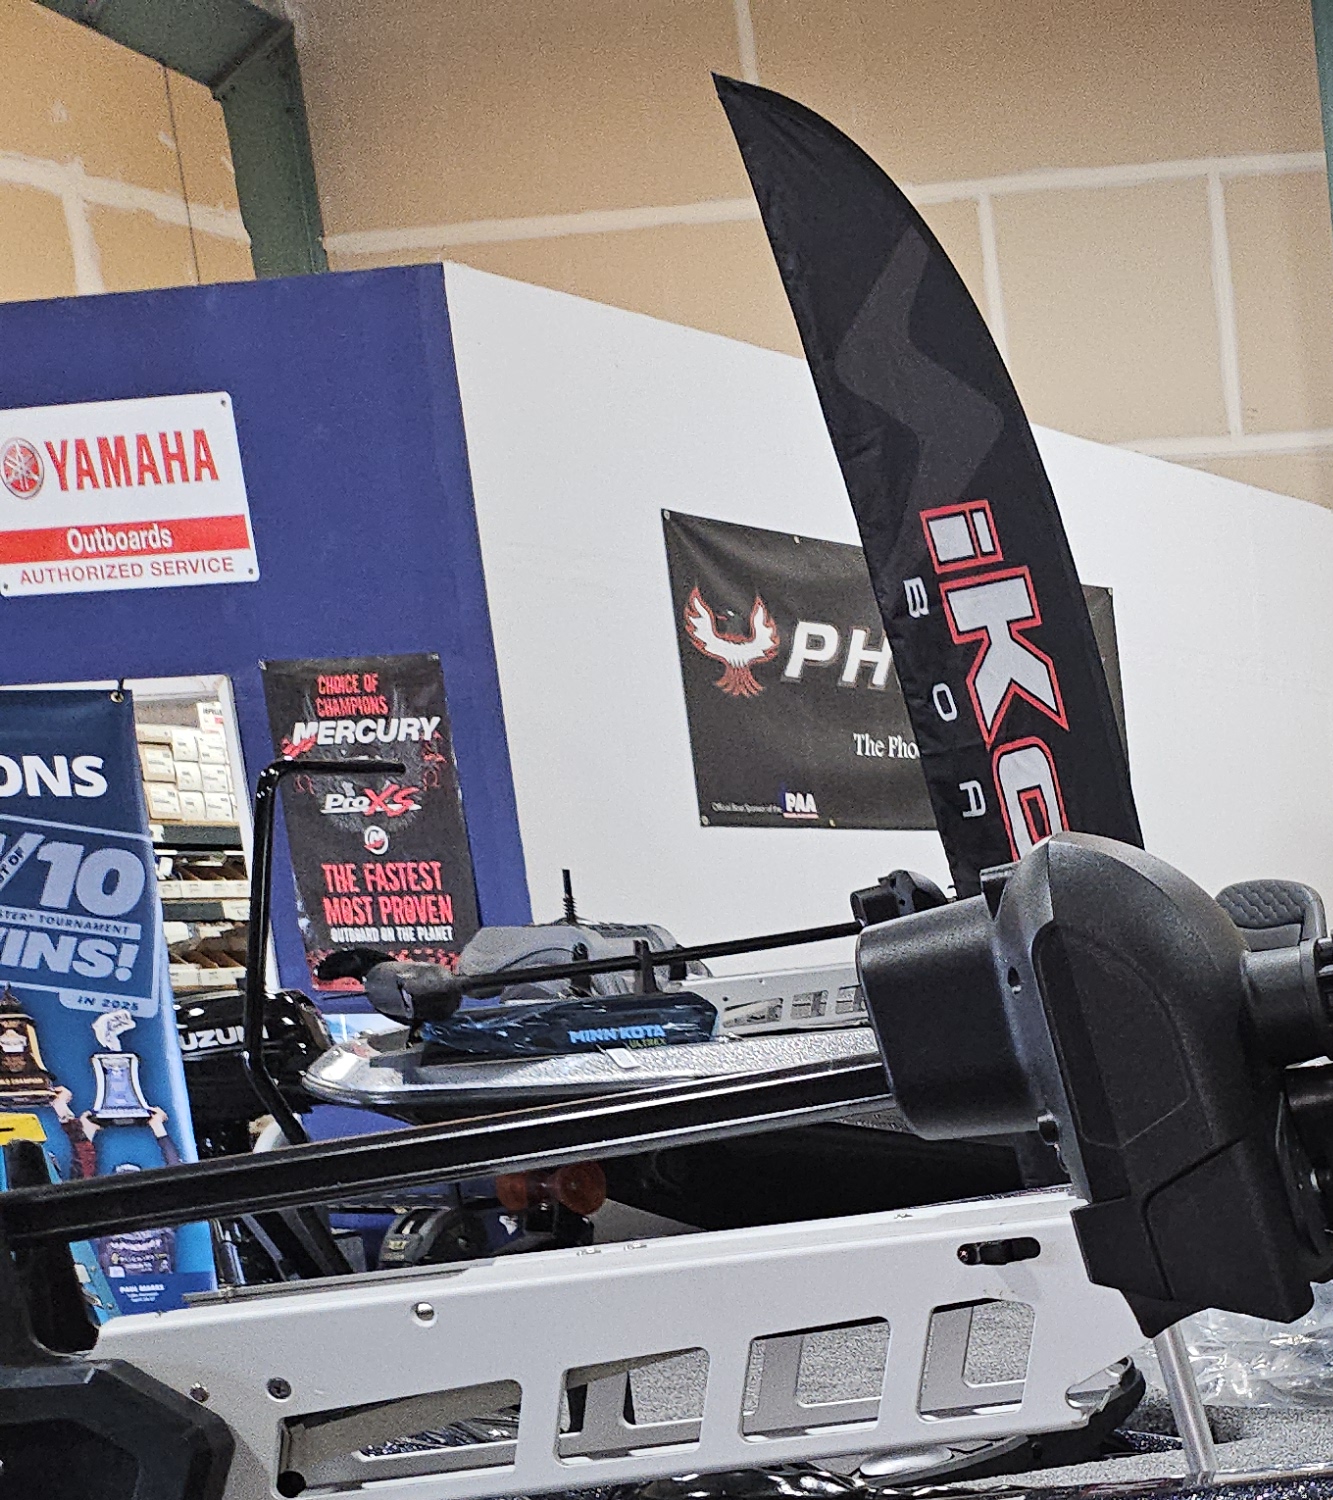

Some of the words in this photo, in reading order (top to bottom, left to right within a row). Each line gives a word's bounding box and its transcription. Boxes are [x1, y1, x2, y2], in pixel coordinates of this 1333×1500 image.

[44, 429, 219, 491] YAMAHA
[67, 523, 173, 554] Outboards
[20, 562, 143, 585] AUTHORIZED
[151, 557, 234, 577] SERVICE
[317, 674, 360, 695] CHOICE
[363, 672, 378, 693] OF
[315, 695, 389, 718] CHAMPIONS
[292, 716, 441, 746] MERCURY
[854, 733, 886, 757] The
[784, 791, 818, 814] PAA
[321, 863, 360, 893] THE
[362, 861, 442, 892] FASTEST
[322, 896, 373, 926] MOST
[377, 894, 454, 925] PROVEN
[39, 914, 130, 935] TOURNAMENT
[396, 926, 417, 942] THE
[416, 926, 454, 942] PLANET
[0, 926, 139, 982] INS!
[77, 995, 96, 1005] IN
[568, 1027, 619, 1044] MINN
[619, 1024, 667, 1040] KOTA
